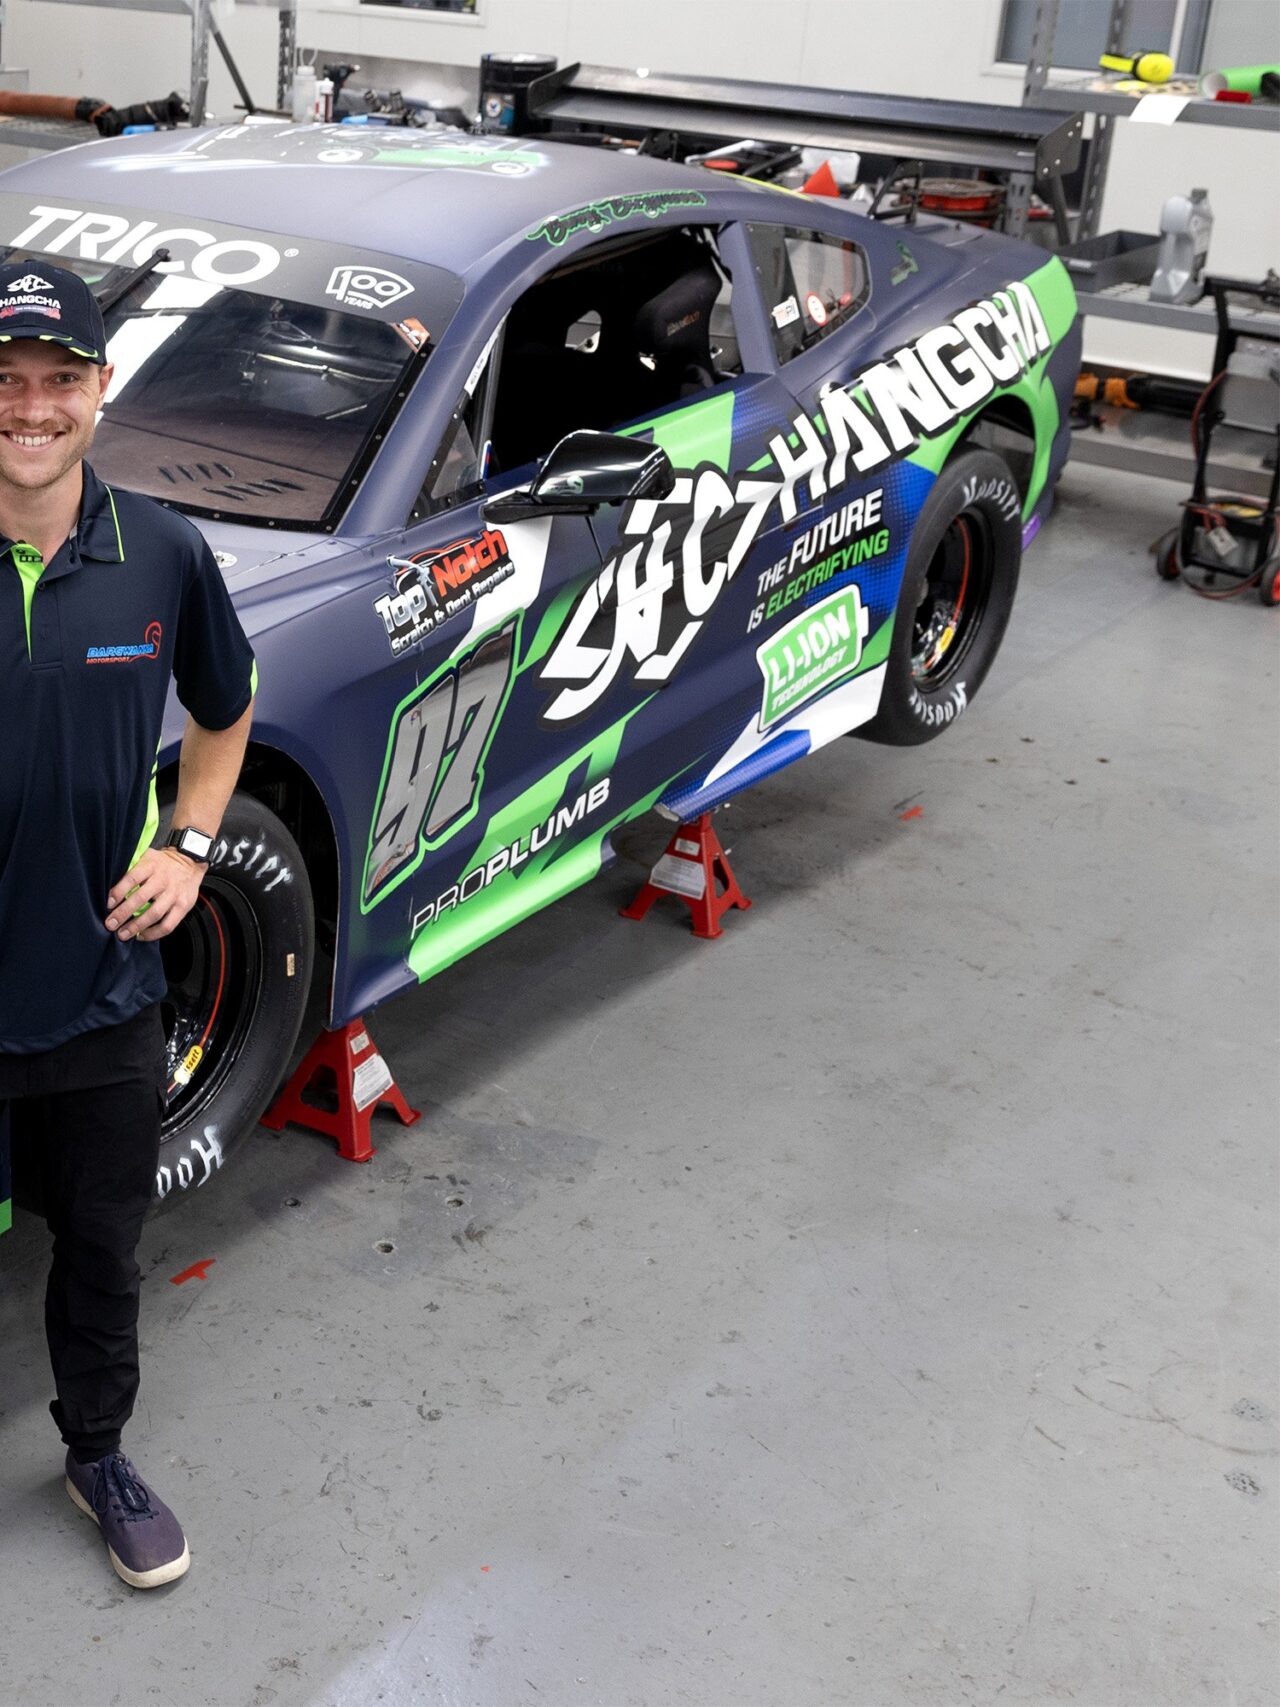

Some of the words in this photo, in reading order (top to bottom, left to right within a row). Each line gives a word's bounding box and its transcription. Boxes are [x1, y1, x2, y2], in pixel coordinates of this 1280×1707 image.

[10, 205, 281, 286] TRICO
[335, 270, 402, 301] 100
[0, 294, 62, 309] HANGCHA
[343, 295, 375, 310] YEARS
[769, 280, 1052, 524] HANGCHA
[431, 530, 508, 597] Notch
[746, 602, 765, 634] IS
[765, 528, 890, 620] ELECTRIFYING
[756, 557, 788, 598] THE
[787, 487, 884, 575] FUTURE
[374, 584, 428, 634] Top
[390, 617, 434, 652] Scratch
[445, 589, 472, 616] Dent
[471, 560, 514, 598] Repairs
[767, 604, 852, 694] LI-ION
[364, 620, 517, 904] 97
[409, 776, 611, 941] PROPLUMB
